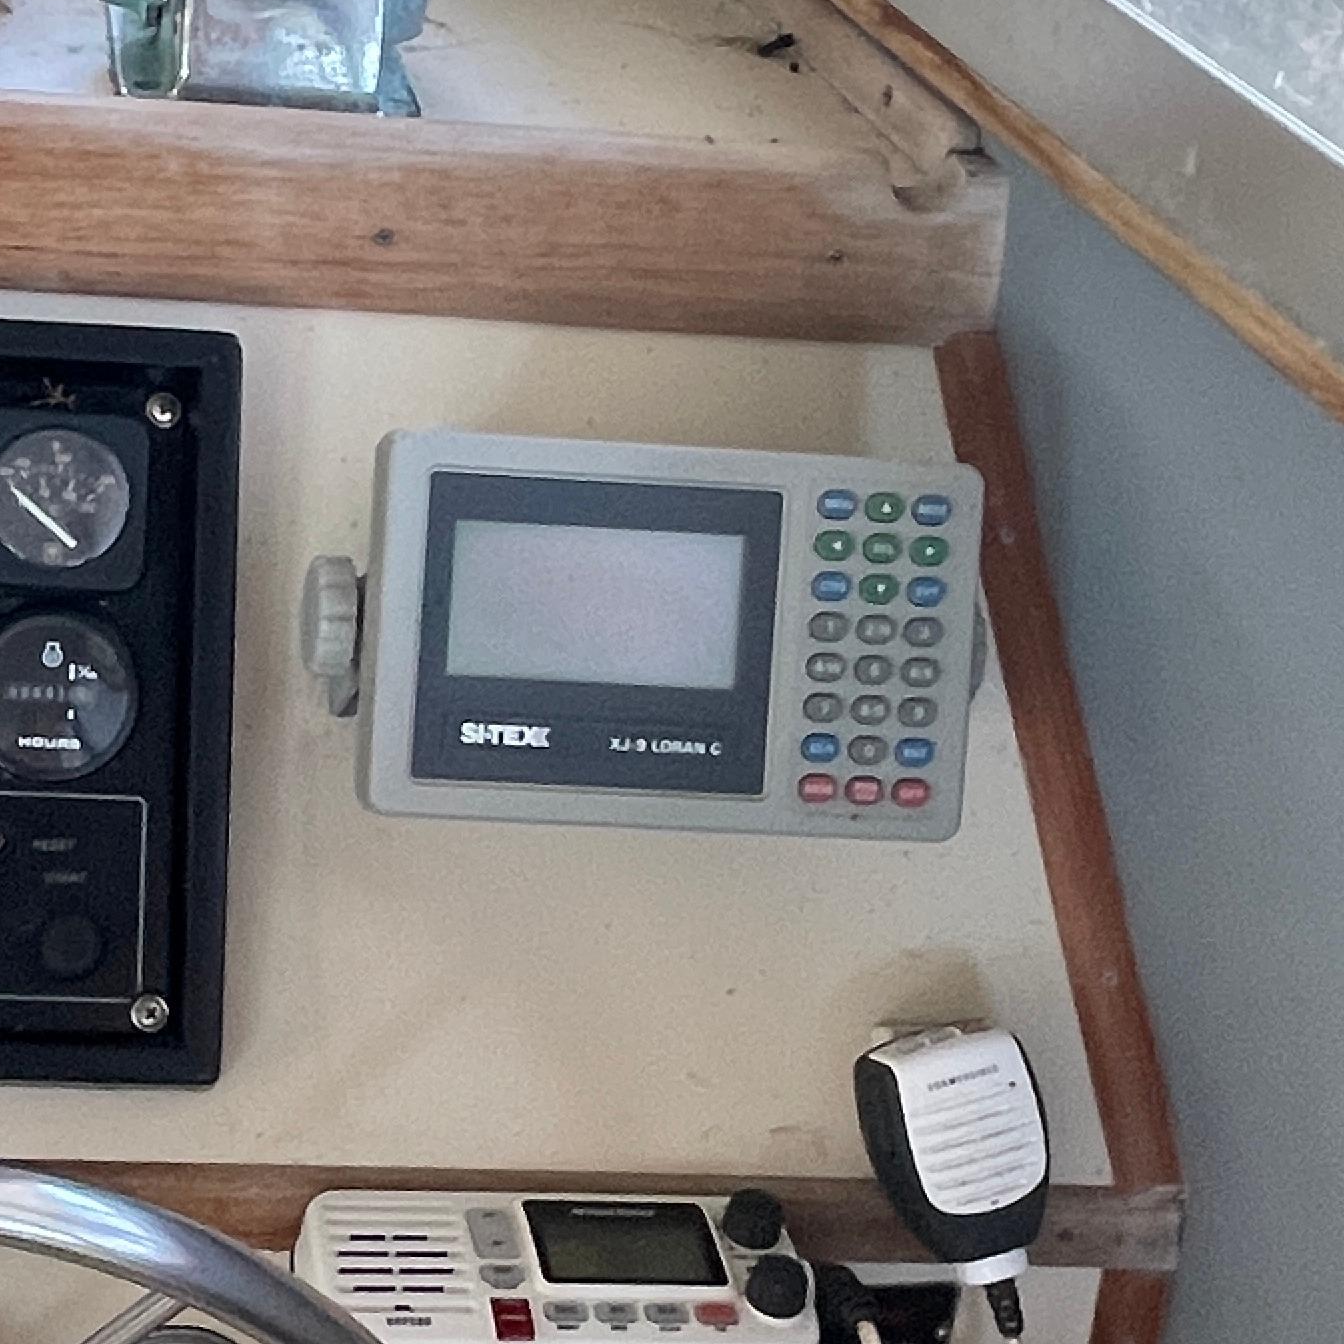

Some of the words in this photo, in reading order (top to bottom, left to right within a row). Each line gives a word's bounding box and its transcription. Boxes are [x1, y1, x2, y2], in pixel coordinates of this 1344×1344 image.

[18, 736, 81, 750] HOURS
[651, 740, 706, 754] LORAN
[710, 742, 722, 756] C
